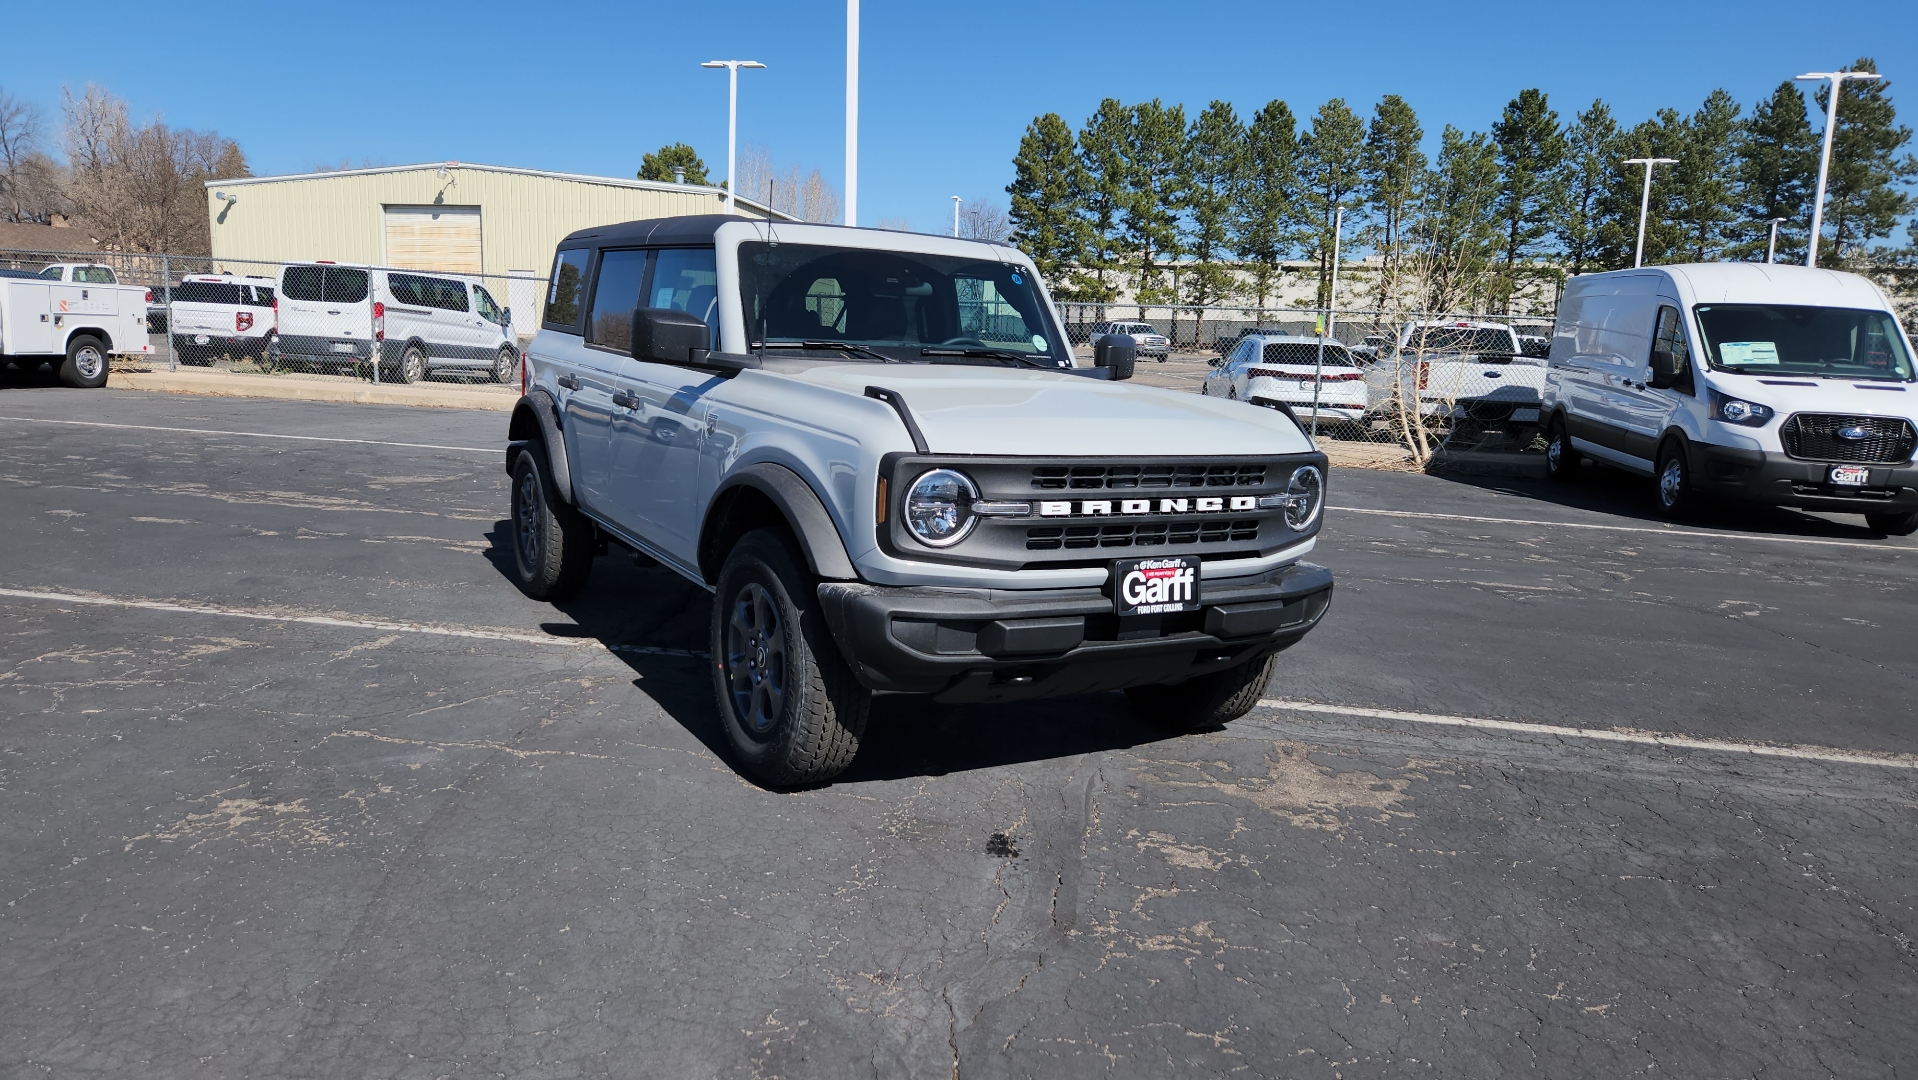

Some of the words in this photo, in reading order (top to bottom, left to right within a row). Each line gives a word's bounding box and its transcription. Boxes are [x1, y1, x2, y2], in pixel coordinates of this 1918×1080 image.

[1831, 468, 1868, 482] Garff
[1040, 497, 1256, 516] BRONCO
[1162, 559, 1181, 568] Garff
[1122, 568, 1194, 605] Garff
[1138, 605, 1150, 614] FORD
[1150, 604, 1163, 613] FORT
[1164, 603, 1183, 612] COLLINS
